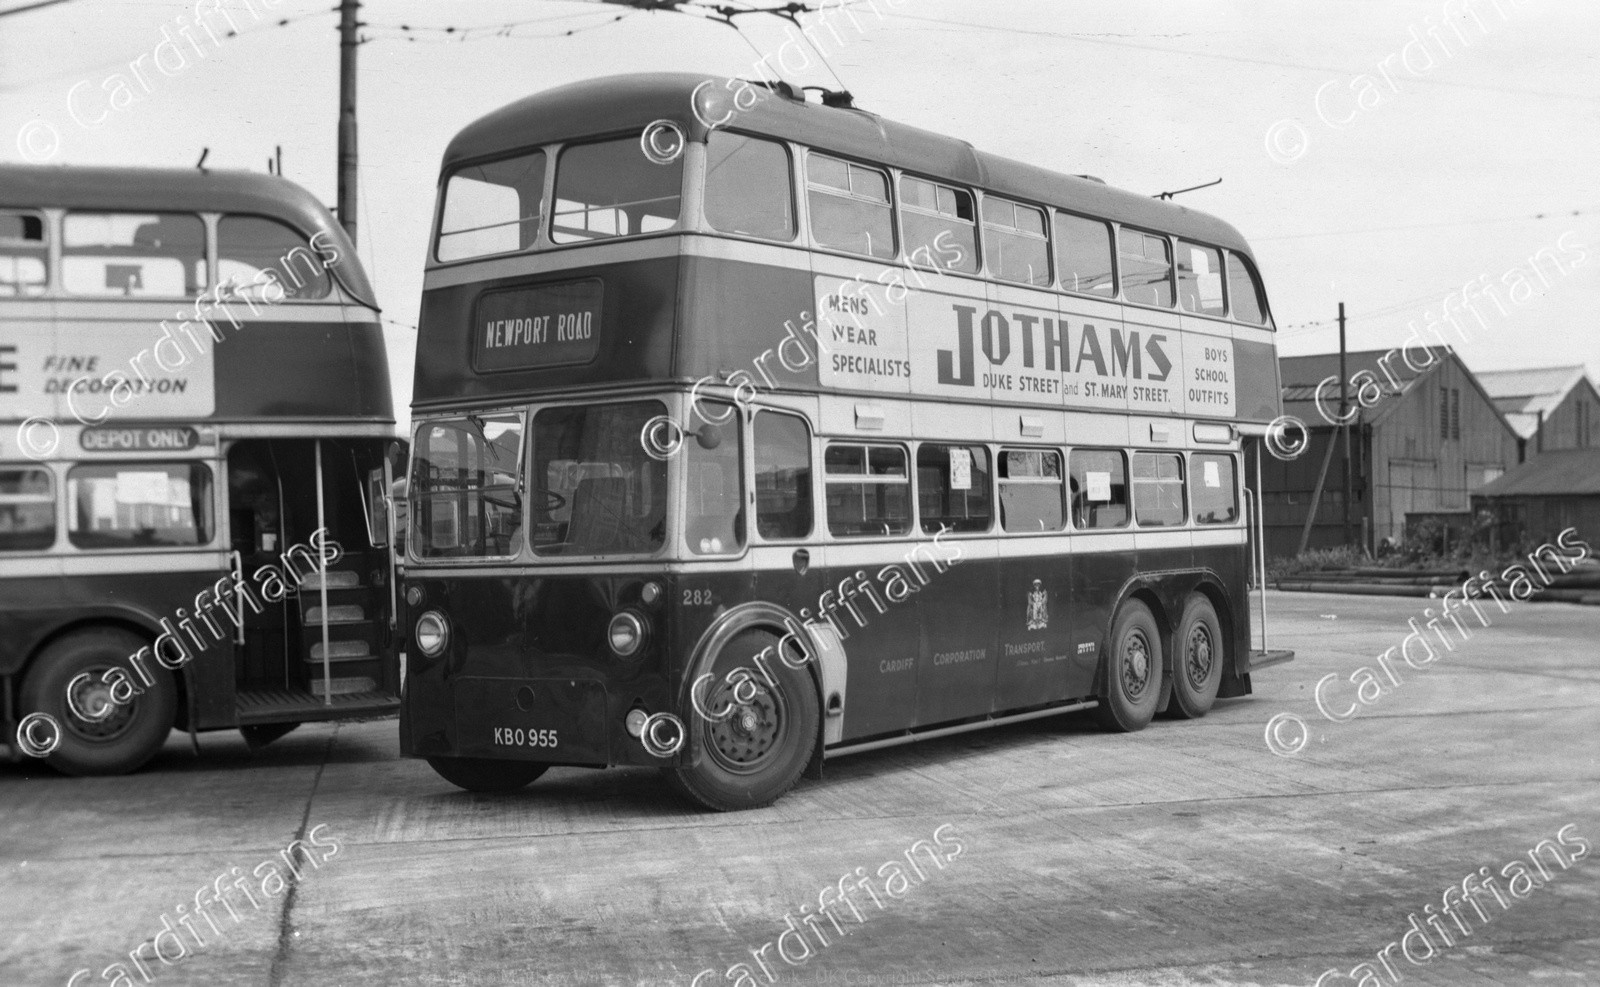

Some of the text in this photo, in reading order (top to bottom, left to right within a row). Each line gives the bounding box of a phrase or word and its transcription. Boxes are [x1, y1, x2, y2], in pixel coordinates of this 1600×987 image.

[828, 294, 868, 315] MENS
[485, 311, 592, 348] NEWPORT ROAD
[832, 325, 877, 346] WEAR
[937, 304, 1173, 387] JOTHAMS
[1204, 347, 1228, 362] BOYS
[43, 355, 99, 372] FINE
[832, 353, 911, 378] SPECIALISTS
[1194, 367, 1229, 383] SCHOOL
[43, 378, 188, 394] DECORATION
[983, 373, 1013, 390] DUKE
[1019, 376, 1060, 395] STREET
[1064, 381, 1079, 396] and
[1133, 387, 1171, 403] STREET.
[1188, 388, 1229, 405] OUTFITS
[82, 429, 192, 449] DEPOT ONLY
[683, 589, 713, 606] 282
[879, 657, 914, 674] CARDIFF
[933, 649, 987, 666] CORPORATION
[494, 727, 559, 747] KBO 955
